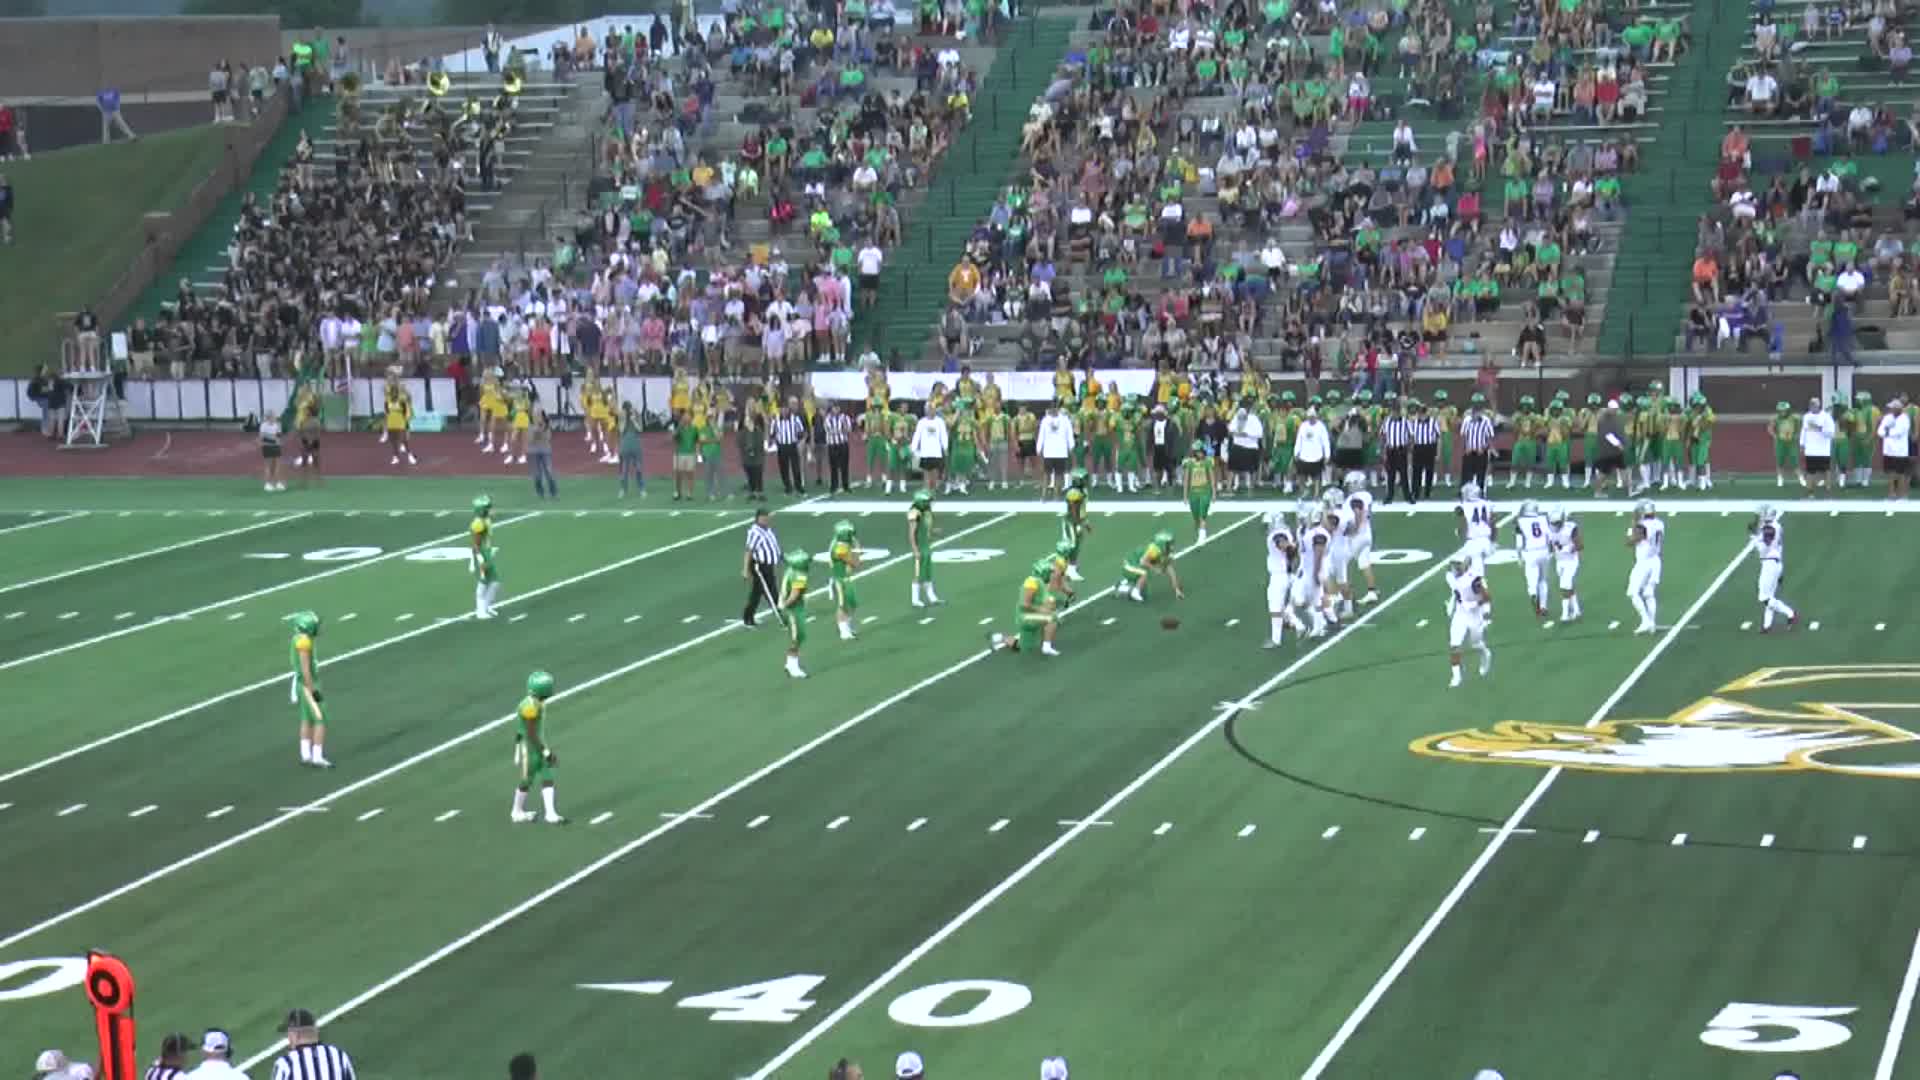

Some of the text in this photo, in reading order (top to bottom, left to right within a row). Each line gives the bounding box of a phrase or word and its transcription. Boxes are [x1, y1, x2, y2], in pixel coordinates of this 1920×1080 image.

[1471, 504, 1488, 526] 44
[1531, 521, 1542, 538] 6
[1699, 1002, 1860, 1053] 5
